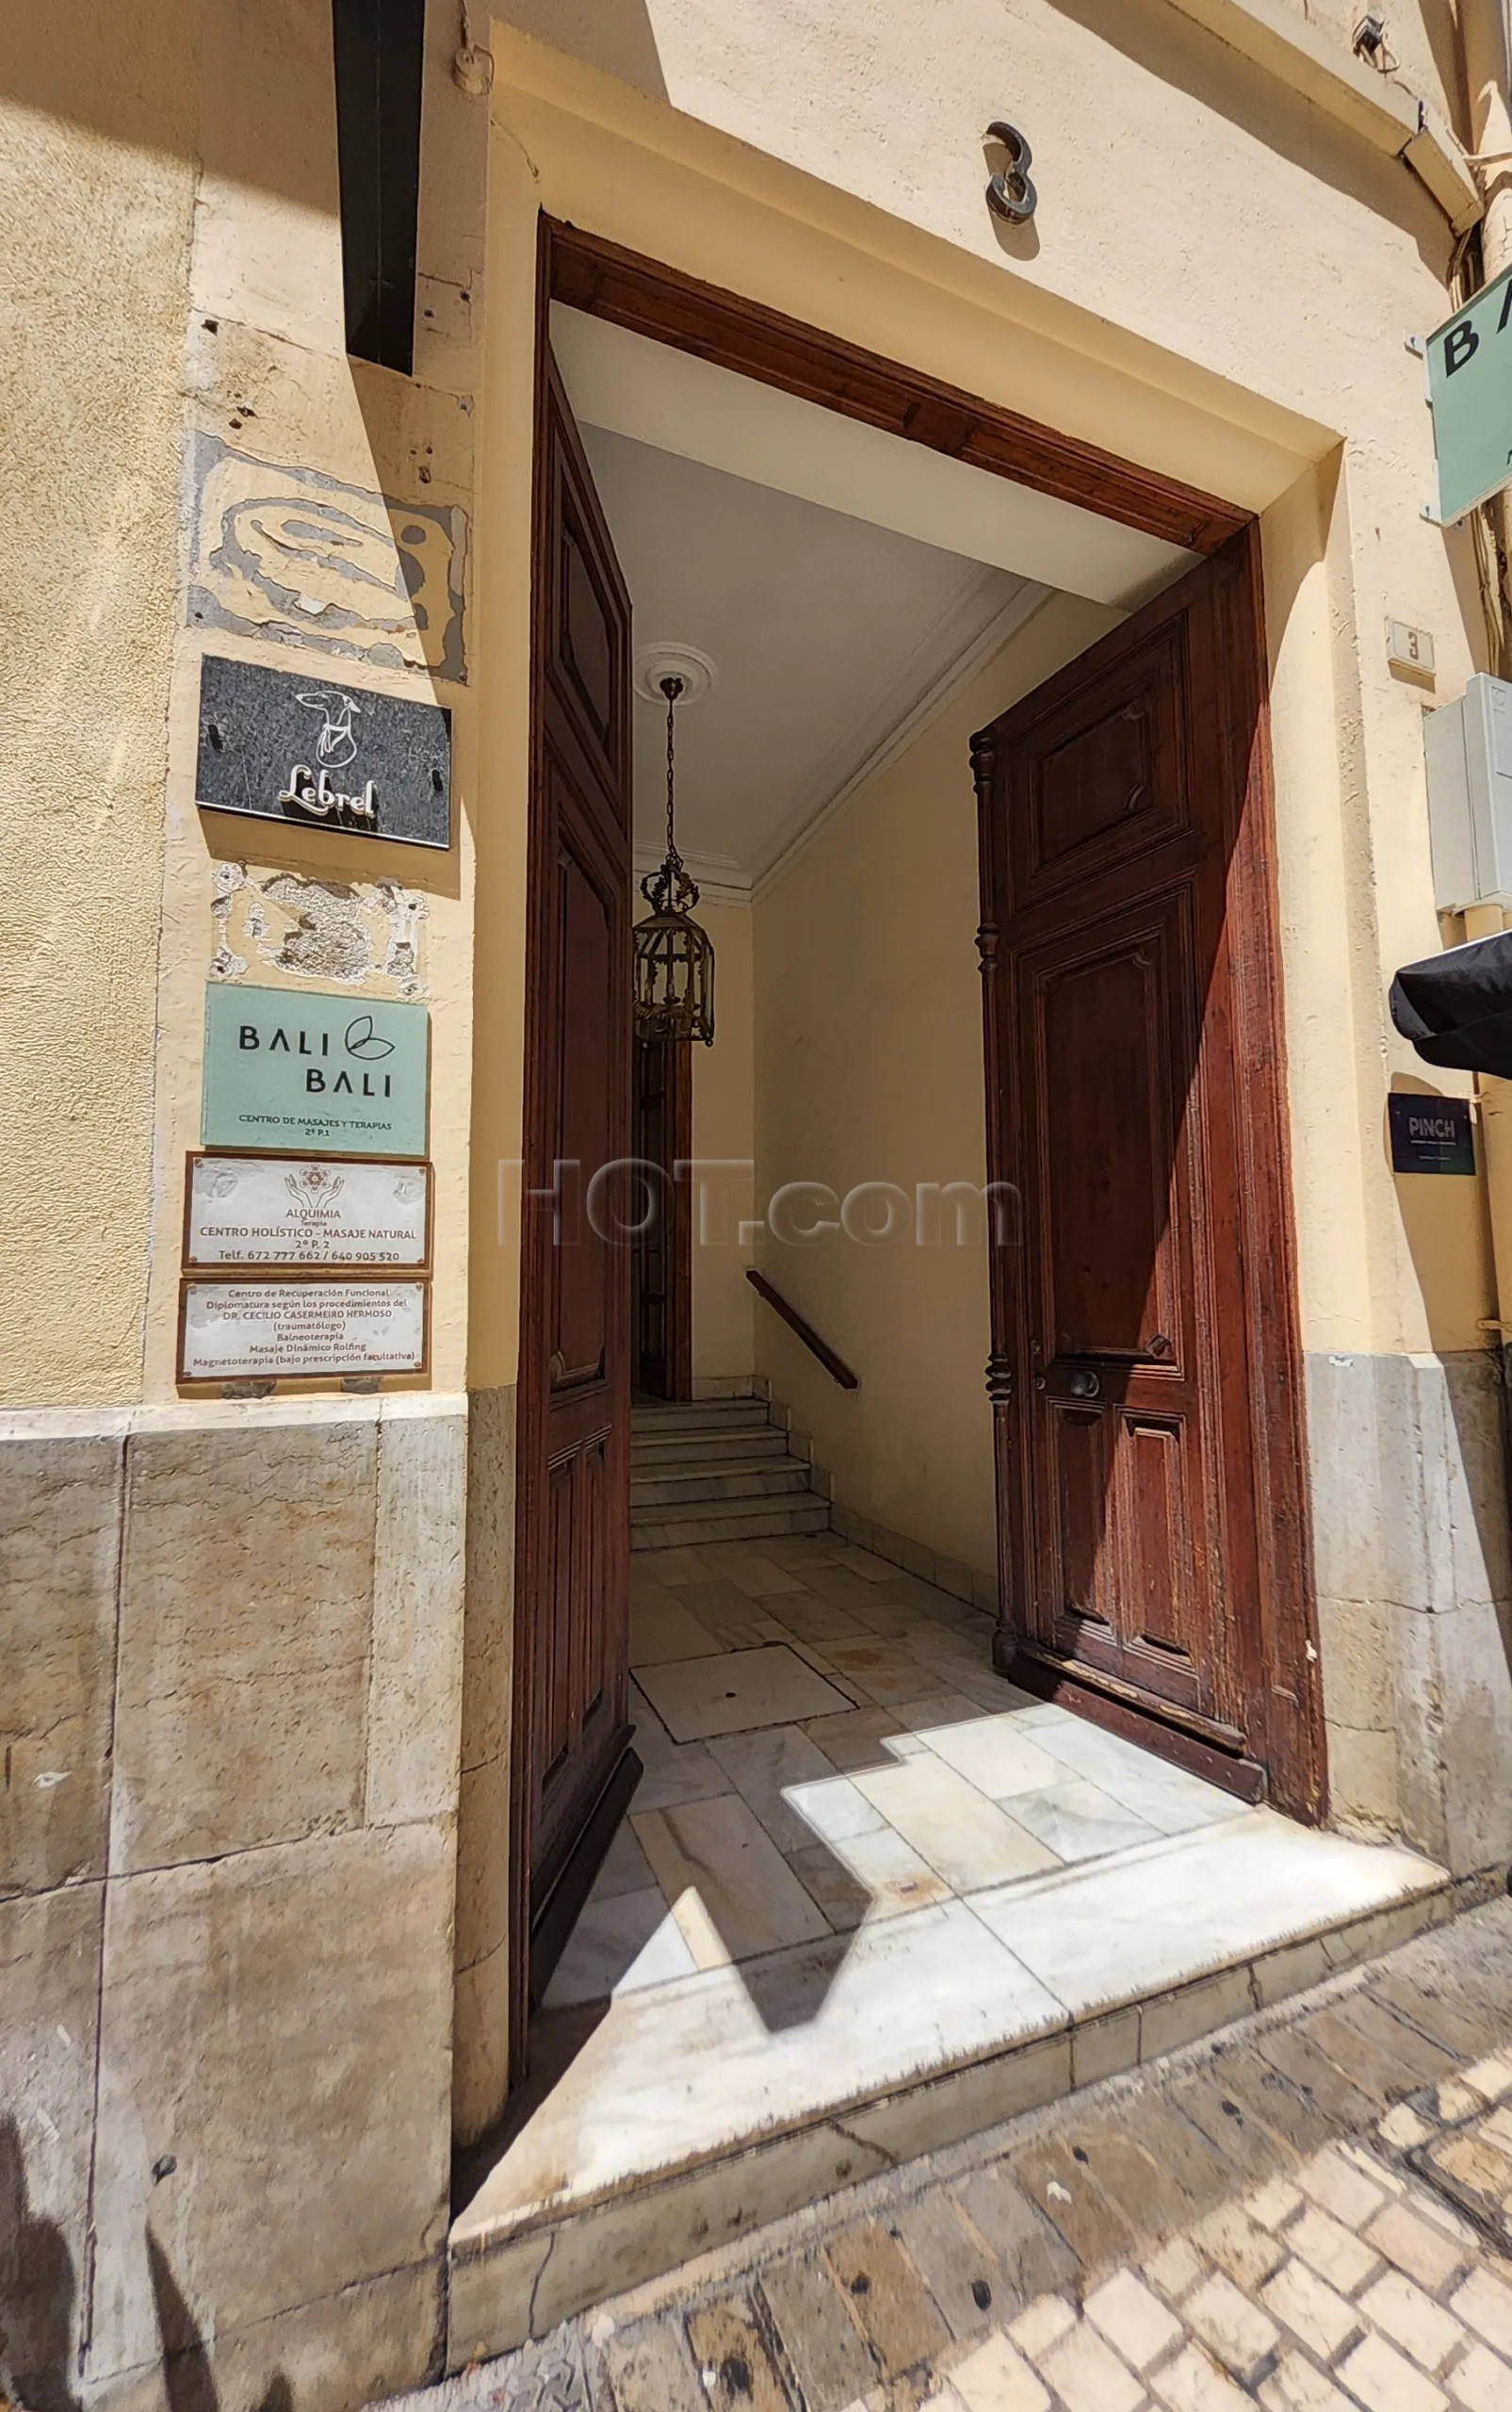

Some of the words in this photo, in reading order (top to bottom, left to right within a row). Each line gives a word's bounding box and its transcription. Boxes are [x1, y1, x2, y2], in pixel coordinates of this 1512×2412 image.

[985, 122, 1038, 225] 3
[1443, 276, 1512, 378] B
[1406, 630, 1420, 660] 3
[278, 764, 377, 818] Lebrel
[239, 1025, 329, 1056] BALI
[306, 1068, 391, 1098] BALI
[238, 1114, 281, 1124] CENTRO
[283, 1116, 296, 1125] DE
[298, 1117, 340, 1128] MASAJES
[340, 1119, 348, 1128] Y
[349, 1120, 392, 1131] TERAPIAS
[1408, 1116, 1455, 1138] PINCH
[285, 1209, 341, 1220] ALQUIMIA
[200, 1227, 249, 1237] CENTRO
[252, 1226, 314, 1238] HOLÍSTICO
[323, 1229, 366, 1239] MASAJE
[368, 1230, 416, 1240] NATURAL
[311, 1240, 320, 1249] P.
[323, 1240, 331, 1249] 2
[219, 1250, 245, 1260] Telf.
[248, 1250, 270, 1261] 672
[273, 1251, 296, 1261] 777
[299, 1251, 320, 1261] 662
[332, 1251, 353, 1261] 640
[355, 1251, 376, 1262] 905
[379, 1252, 400, 1262] 520
[228, 1289, 263, 1298] Centro
[264, 1289, 277, 1298] de
[279, 1289, 344, 1298] Recuperación
[345, 1289, 390, 1297] Funcional
[206, 1301, 269, 1311] Diplomatura
[271, 1300, 301, 1311] según
[302, 1299, 317, 1308] los
[318, 1299, 391, 1310] procedimientos
[393, 1298, 408, 1308] del
[223, 1312, 241, 1320] DR.
[242, 1312, 282, 1320] CECILIO
[284, 1311, 345, 1319] CASERMEIRO
[346, 1310, 392, 1318] HERMOSO
[273, 1321, 346, 1332] (traumatólogo)
[277, 1332, 344, 1342] Balneoterapia
[250, 1345, 284, 1355] Masaje
[285, 1344, 332, 1353] Dinámico
[333, 1343, 366, 1353] Rolfing
[193, 1357, 274, 1368] Magnetoterapia
[275, 1355, 301, 1365] (bajo
[302, 1354, 363, 1364] prescripción
[363, 1351, 415, 1362] facultativa)
